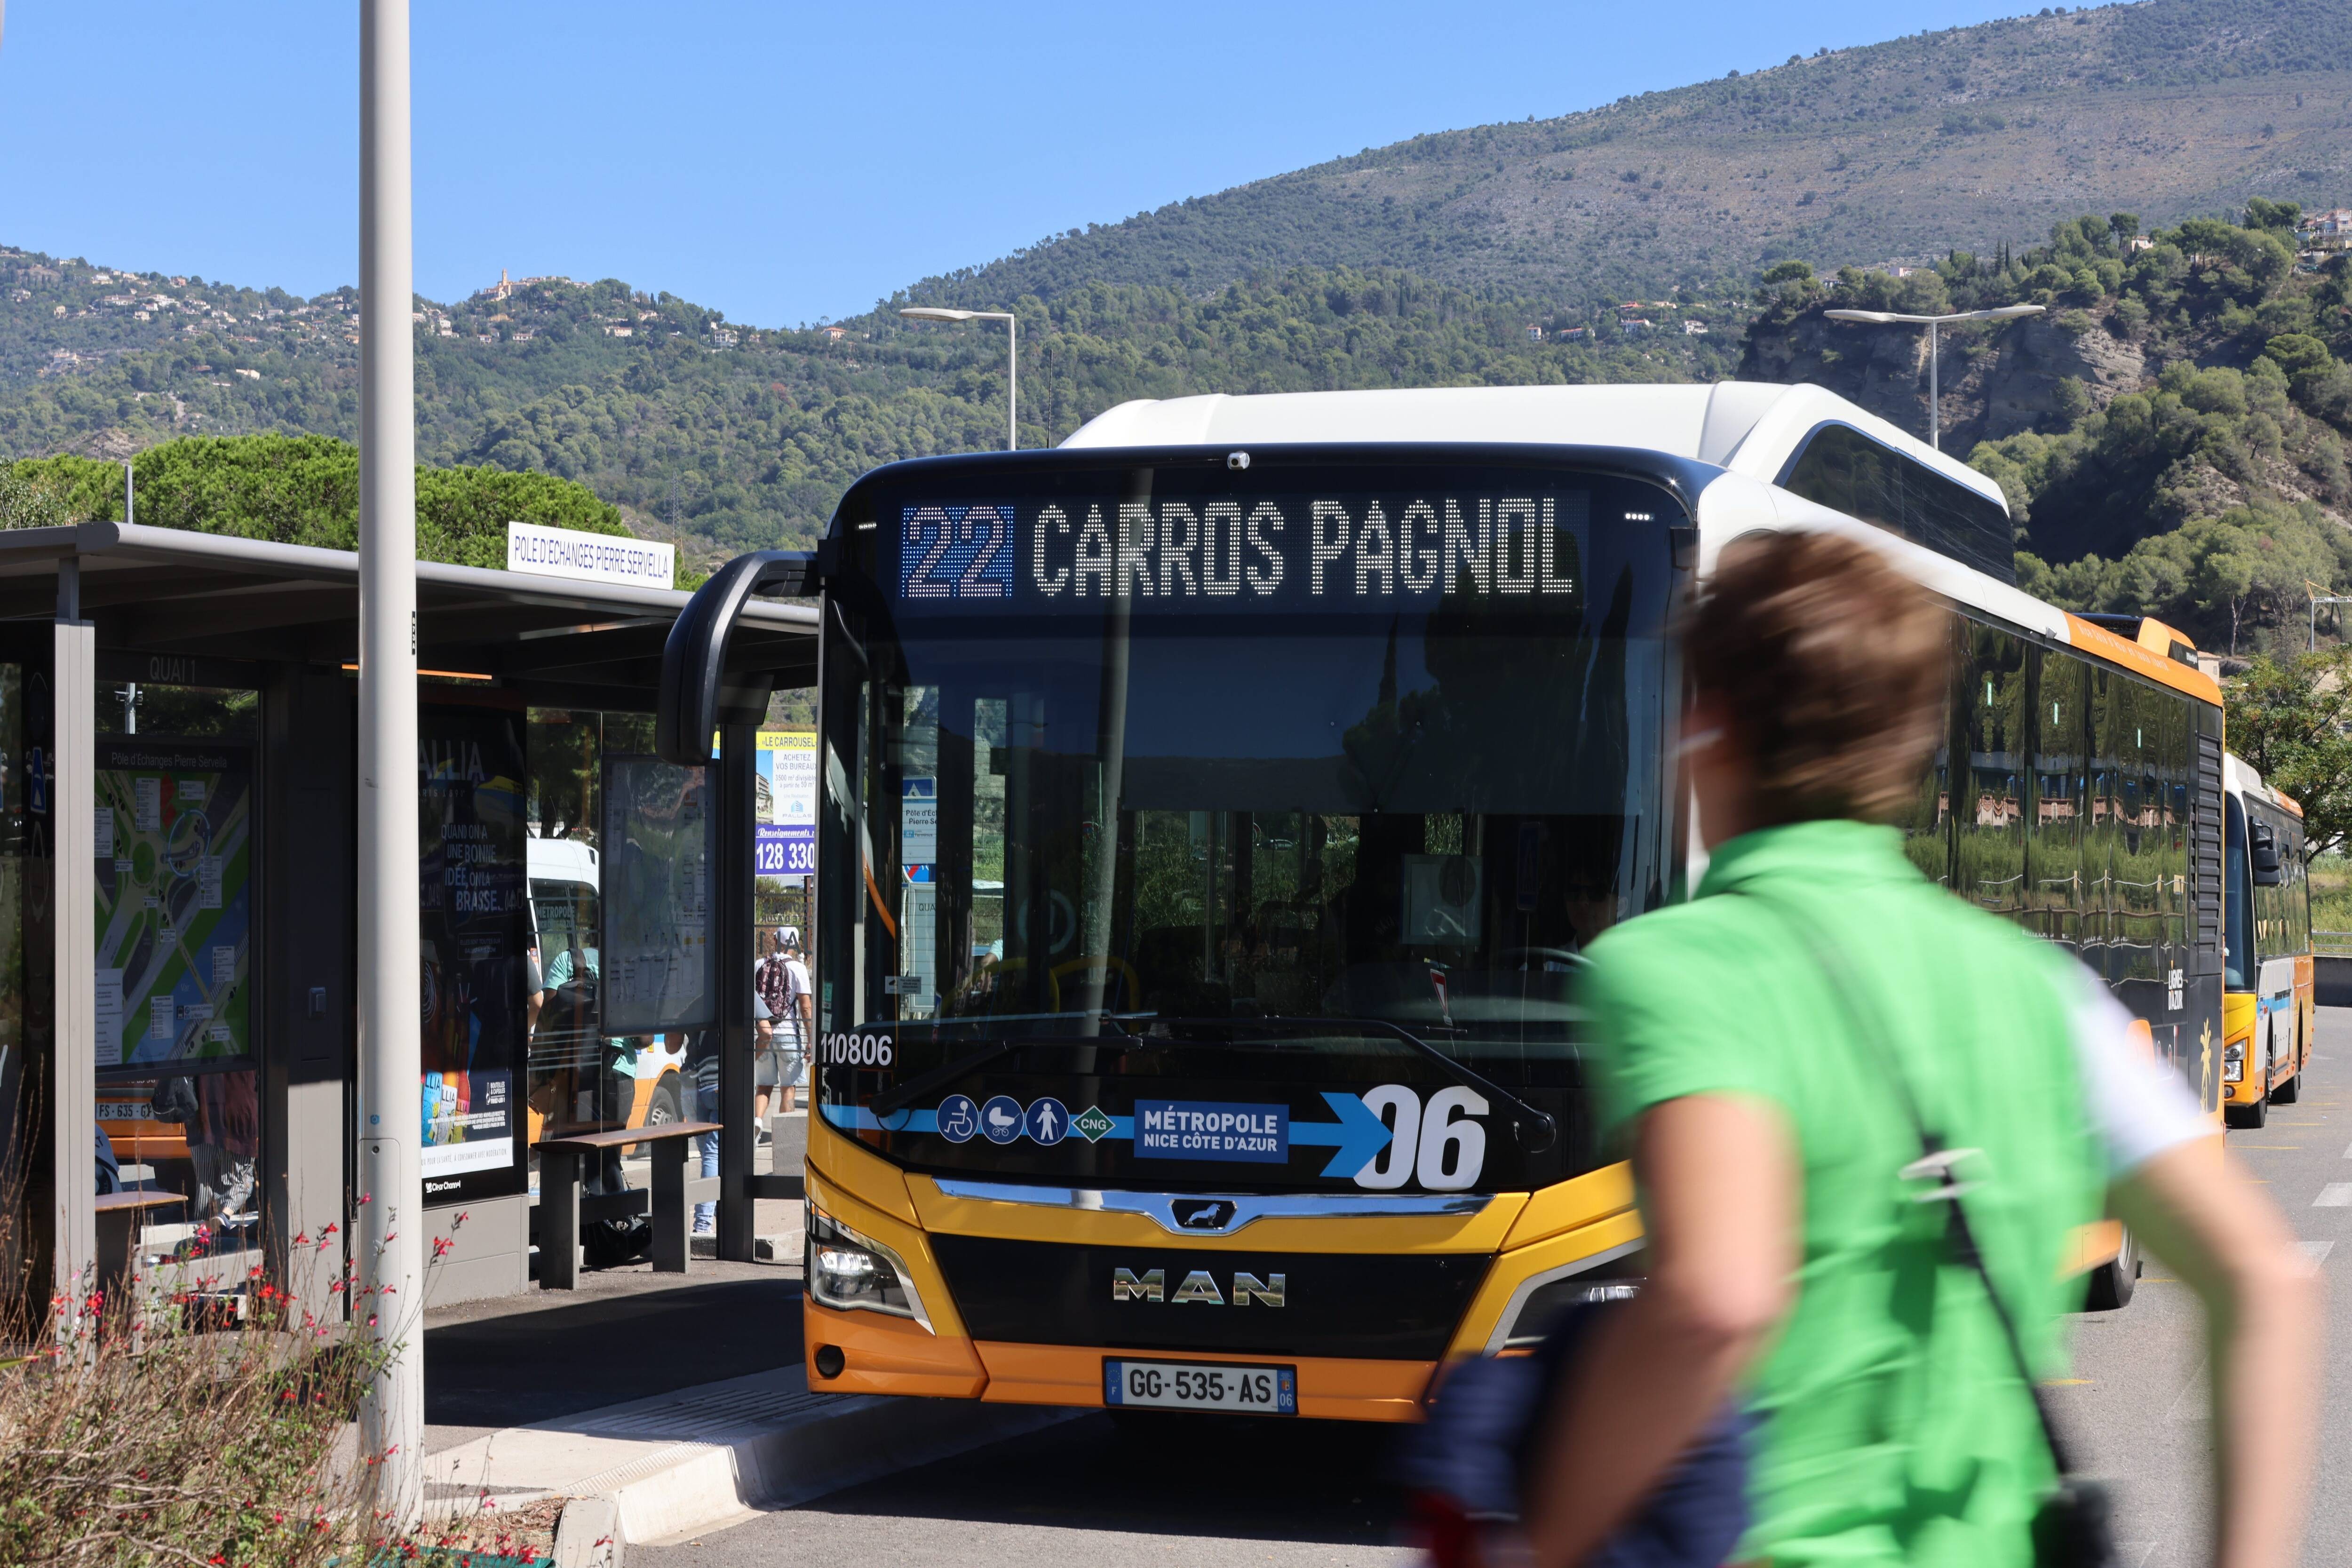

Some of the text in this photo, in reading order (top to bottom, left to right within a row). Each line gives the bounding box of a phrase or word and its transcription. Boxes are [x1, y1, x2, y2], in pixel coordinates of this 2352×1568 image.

[515, 535, 668, 579] POLE D'ECHANGES PIERRE SERVELLA
[908, 498, 1573, 597] 22 CARROS PAGNOL
[150, 657, 196, 683] QUAI 1
[111, 752, 227, 769] Pôle d'Échanges Pierre Servella
[418, 739, 485, 781] ALLIA
[441, 824, 488, 841] QUAND ON A
[757, 827, 810, 837] Renseignements
[447, 844, 497, 863] UNE BONNE
[756, 843, 815, 869] 128 330
[919, 903, 936, 912] QUA
[2168, 968, 2183, 990] LIGNES
[821, 1033, 892, 1067] 110806
[1081, 1118, 1107, 1131] CNG
[1144, 1105, 1277, 1135] MÉTROPOLE
[1144, 1131, 1277, 1152] NICE CÔTE D'AZUR
[1354, 1084, 1489, 1191] 06
[458, 1152, 477, 1162] CONSOMMER
[431, 1179, 461, 1192] Clear Channel
[1113, 1268, 1287, 1307] MAN
[1112, 1386, 1117, 1395] F
[1130, 1369, 1271, 1403] GG-535-AS
[1279, 1393, 1293, 1407] 06
